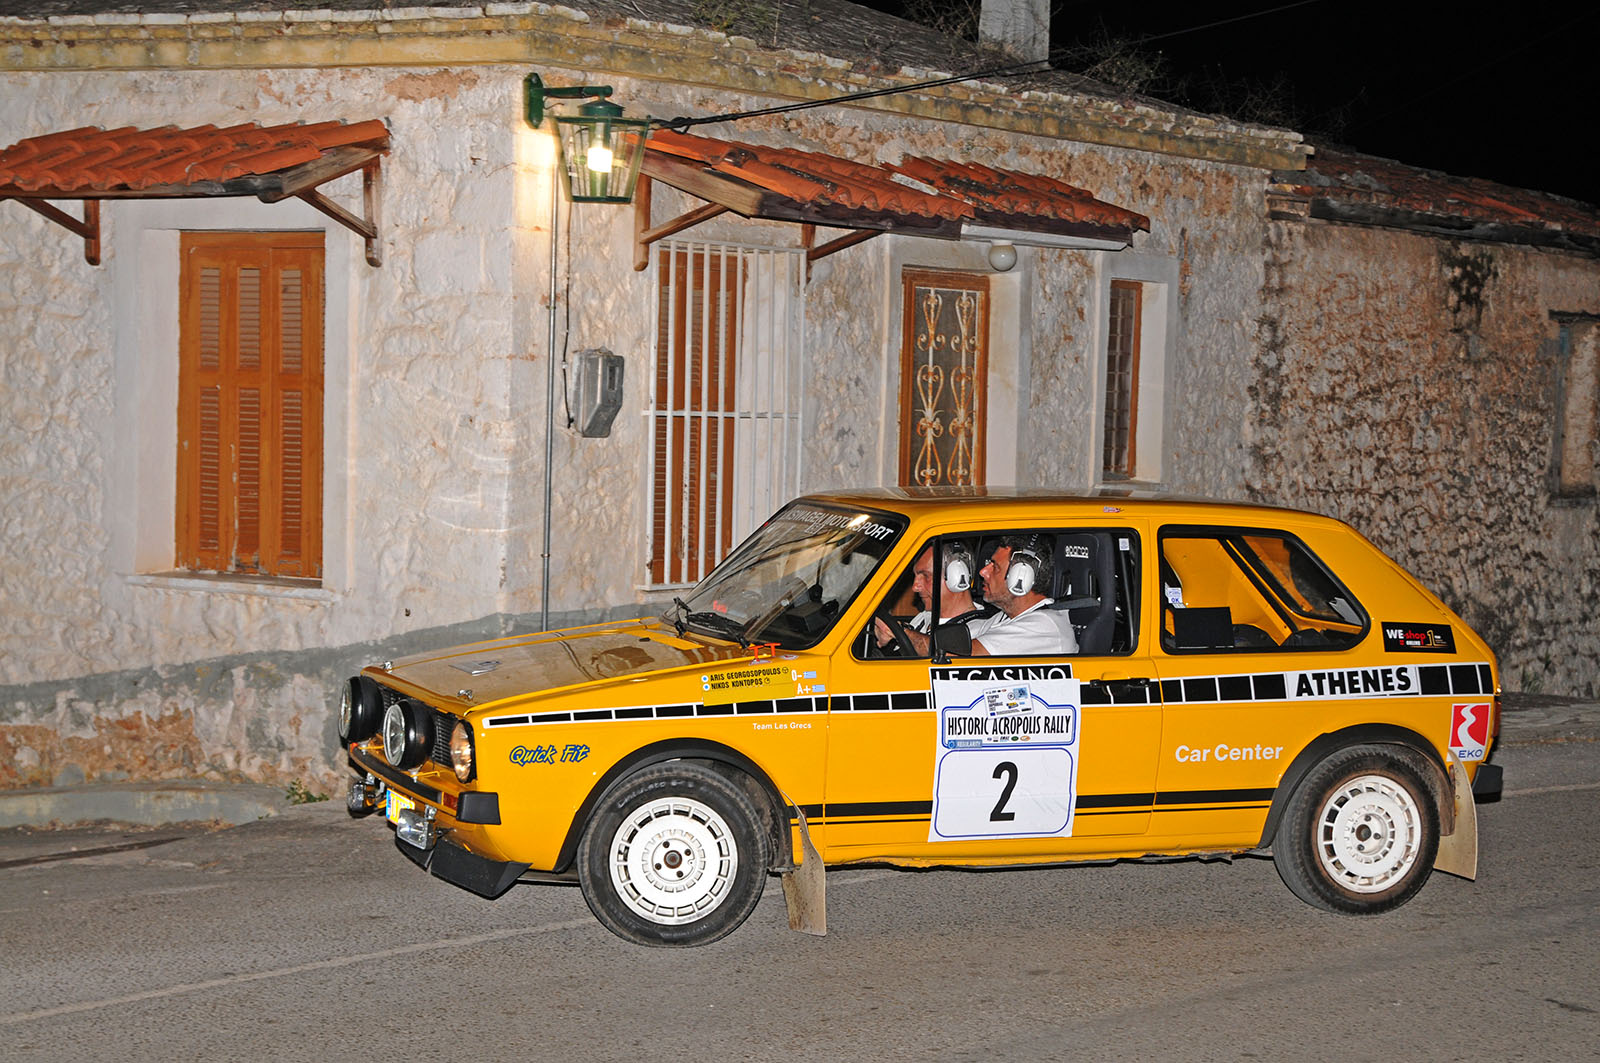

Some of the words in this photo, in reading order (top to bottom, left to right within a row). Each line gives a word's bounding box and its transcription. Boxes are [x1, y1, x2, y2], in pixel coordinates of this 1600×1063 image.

[827, 513, 894, 540] MOTOSPORT
[710, 672, 725, 682] ARIS
[711, 681, 730, 690] NIKOS
[731, 677, 763, 688] KONTOPOS
[1296, 667, 1411, 697] ATHENES
[797, 683, 811, 694] A+
[753, 722, 772, 730] Team
[774, 722, 788, 730] Les
[790, 721, 812, 729] Grecs
[947, 716, 989, 736] HISTORIC
[991, 715, 1042, 736] ACROPOLIS
[1044, 715, 1071, 735] RALLY
[509, 744, 558, 767] Quick
[560, 744, 591, 763] Fit
[1175, 744, 1211, 763] Car
[1214, 743, 1284, 762] Center
[1458, 749, 1483, 759] EKO
[989, 761, 1018, 822] 2
